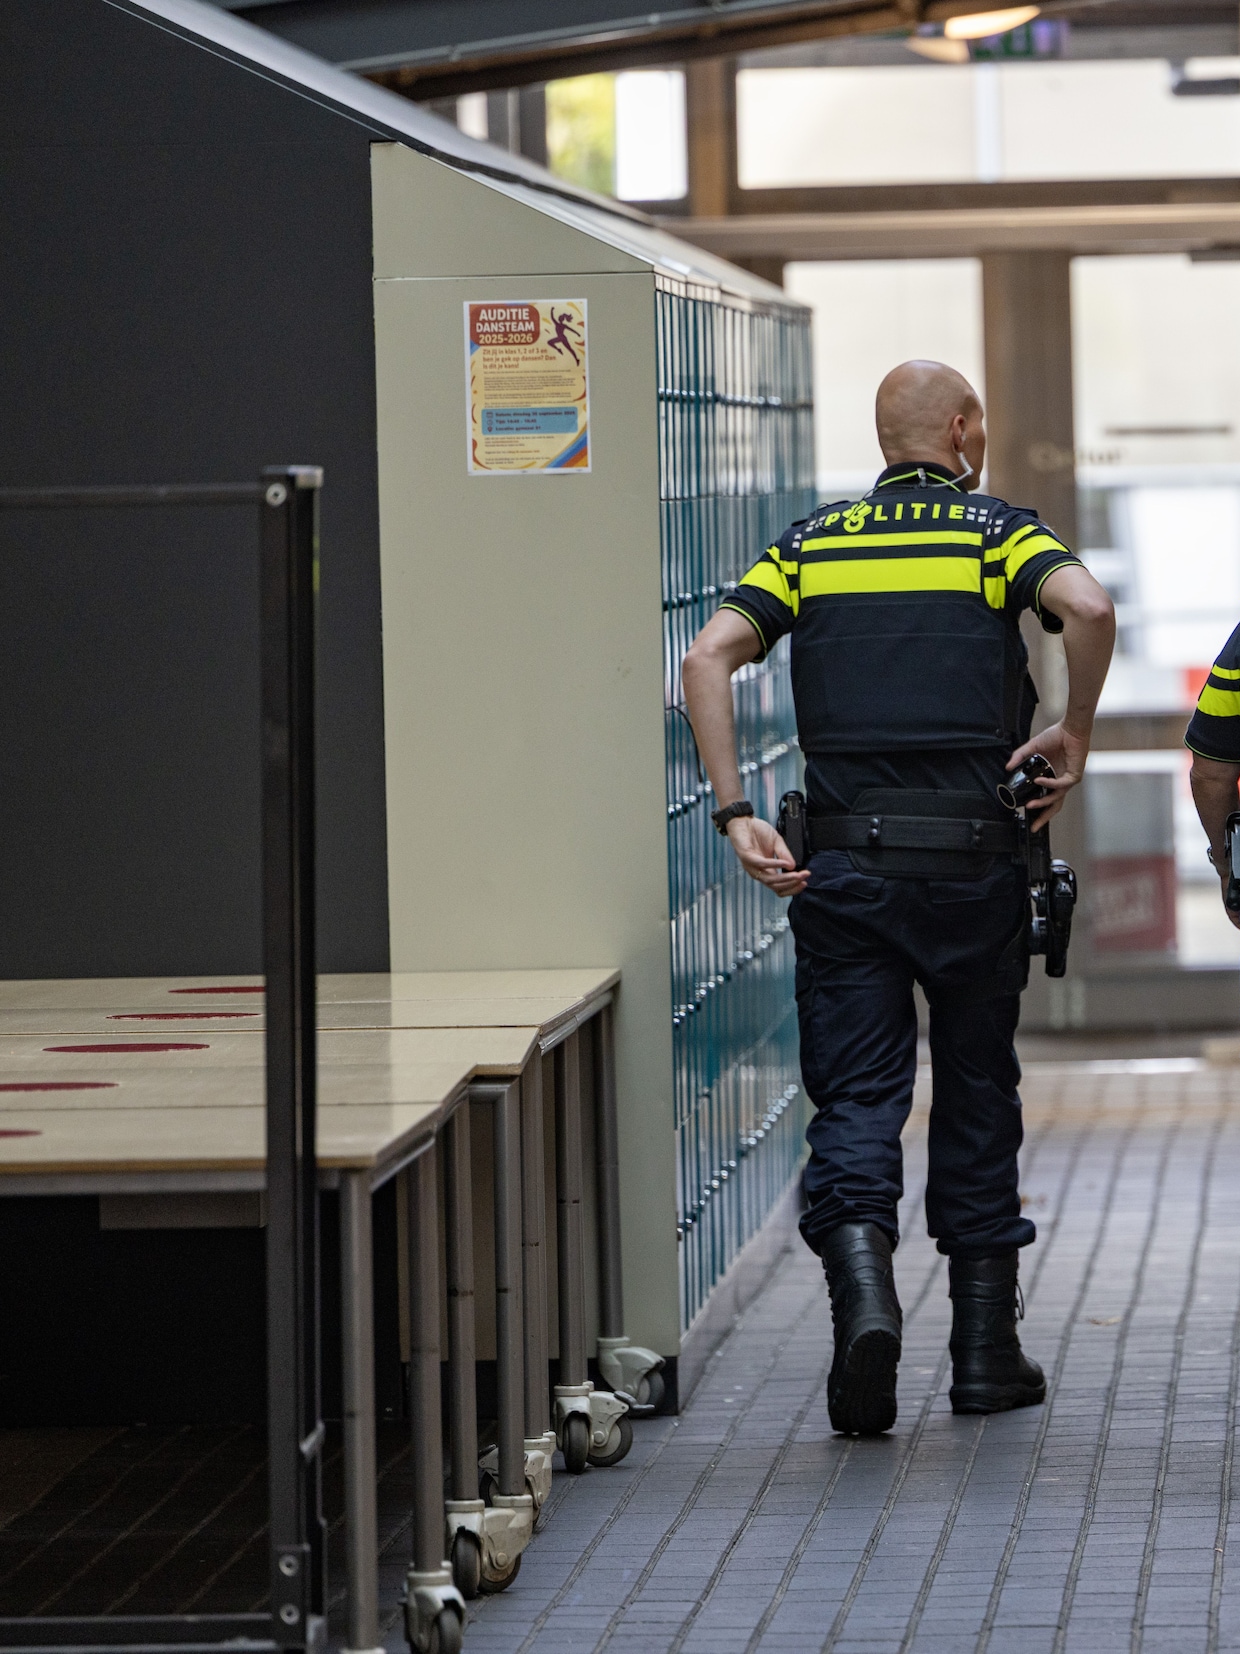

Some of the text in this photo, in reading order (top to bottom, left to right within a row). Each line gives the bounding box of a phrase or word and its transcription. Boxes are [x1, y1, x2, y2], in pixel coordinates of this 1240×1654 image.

[479, 308, 530, 321] AUDITIE
[476, 321, 535, 333] DANSTEAM
[478, 333, 533, 344] 2025-2026
[824, 500, 966, 533] POLITIE
